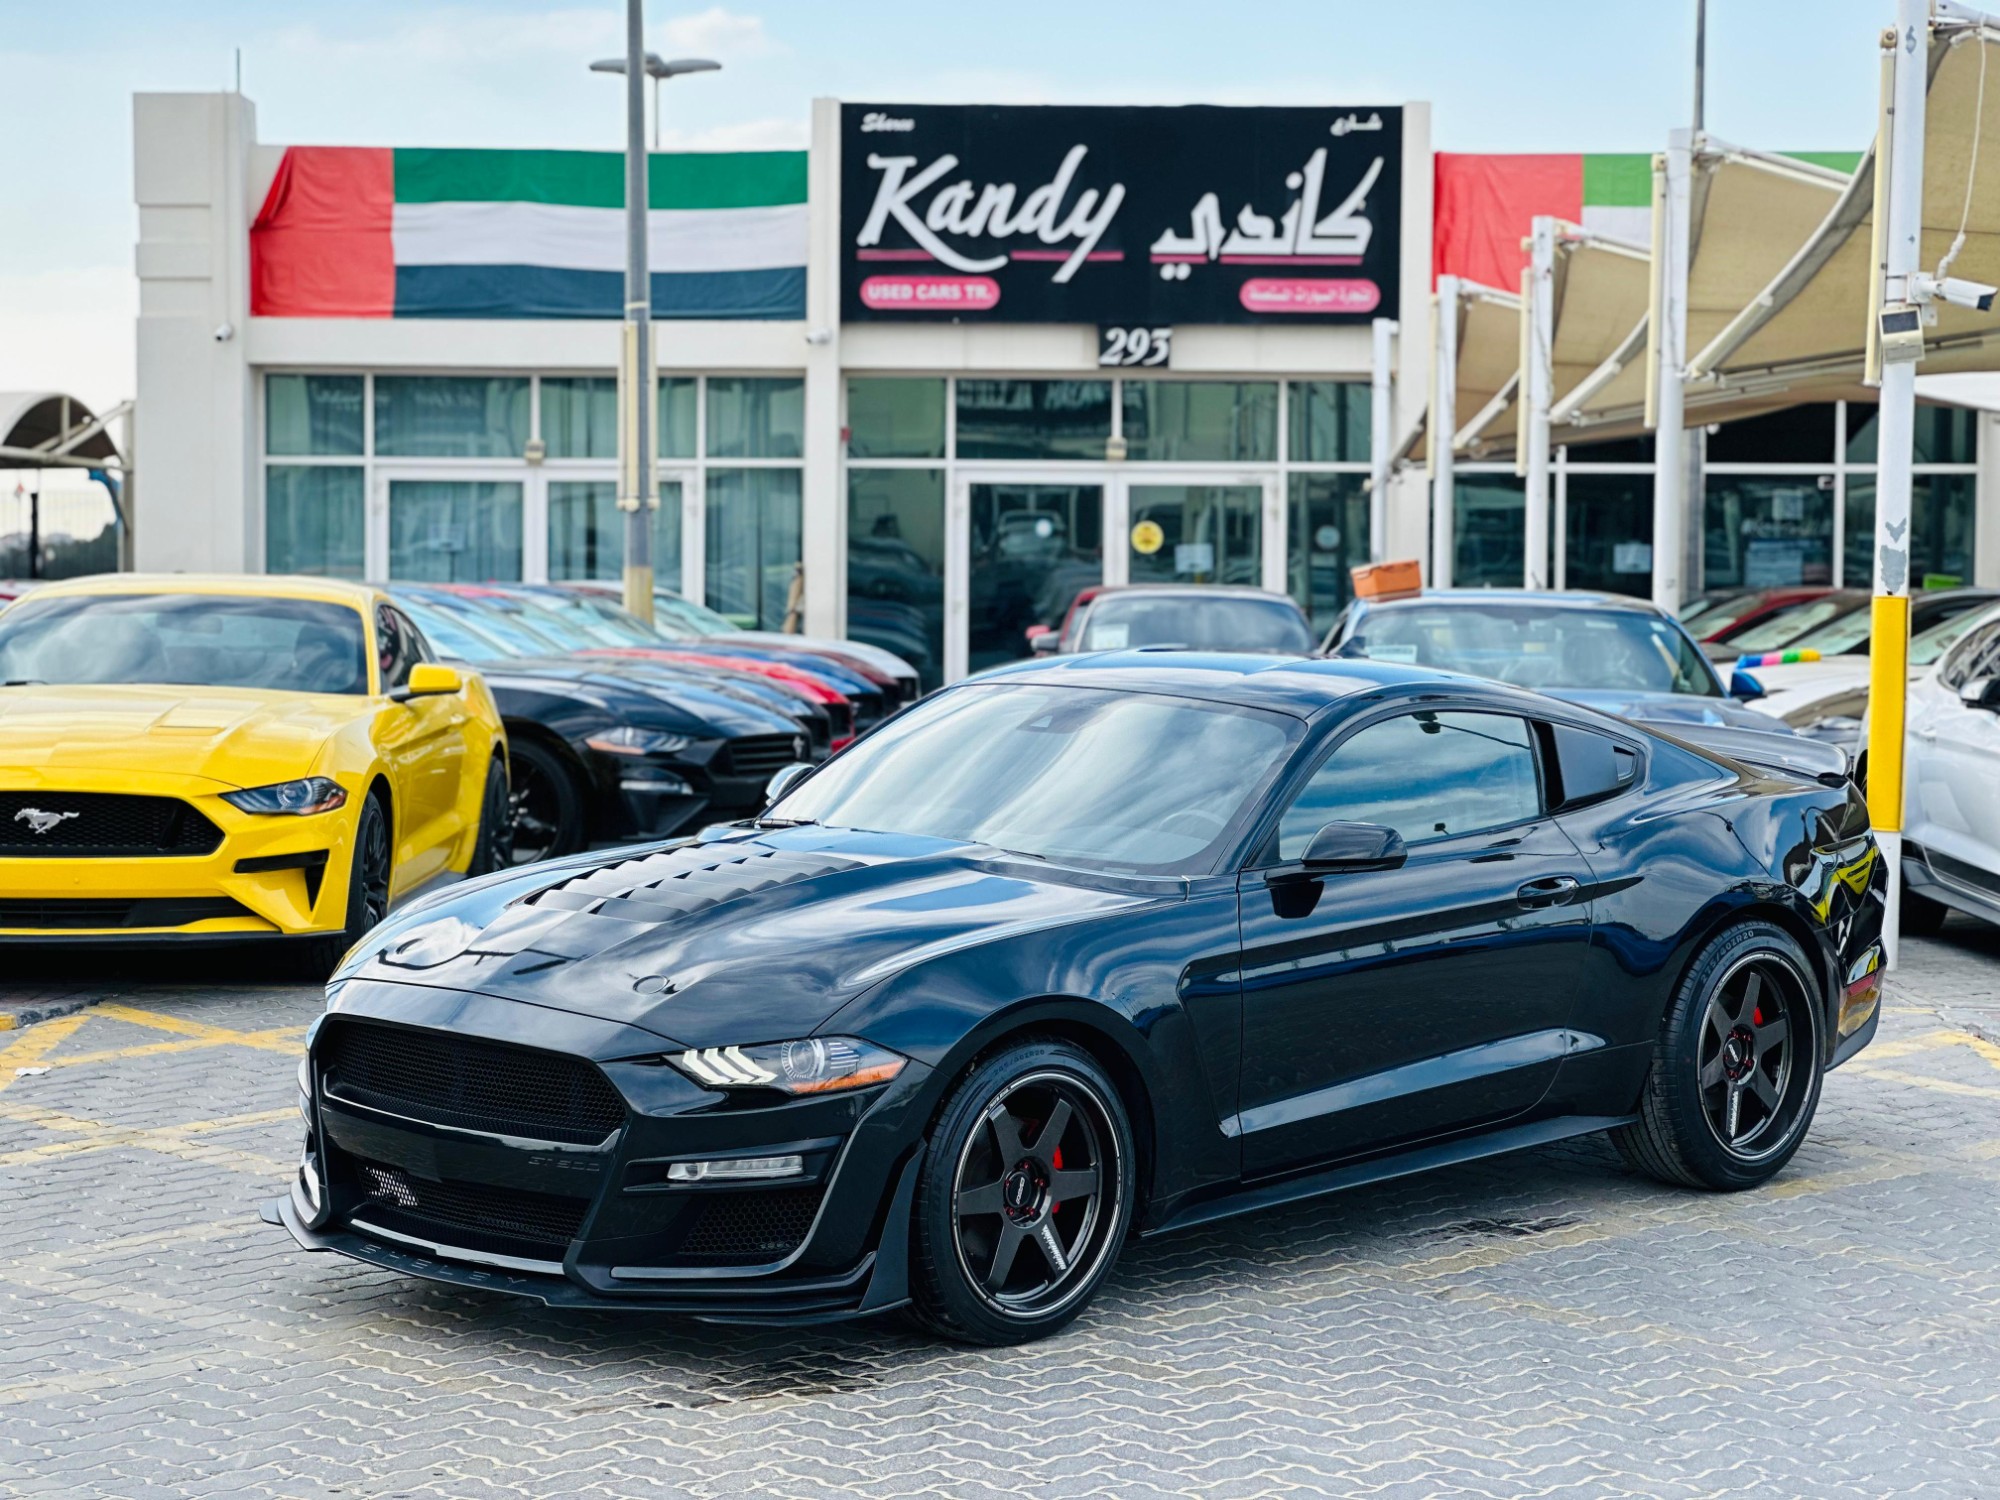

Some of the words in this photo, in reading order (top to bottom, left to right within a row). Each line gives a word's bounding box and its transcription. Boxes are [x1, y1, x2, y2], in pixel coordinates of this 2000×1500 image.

[856, 143, 1126, 283] Kandy
[1150, 147, 1384, 281] كاندي
[867, 283, 914, 300] USED
[915, 283, 963, 300] CARS
